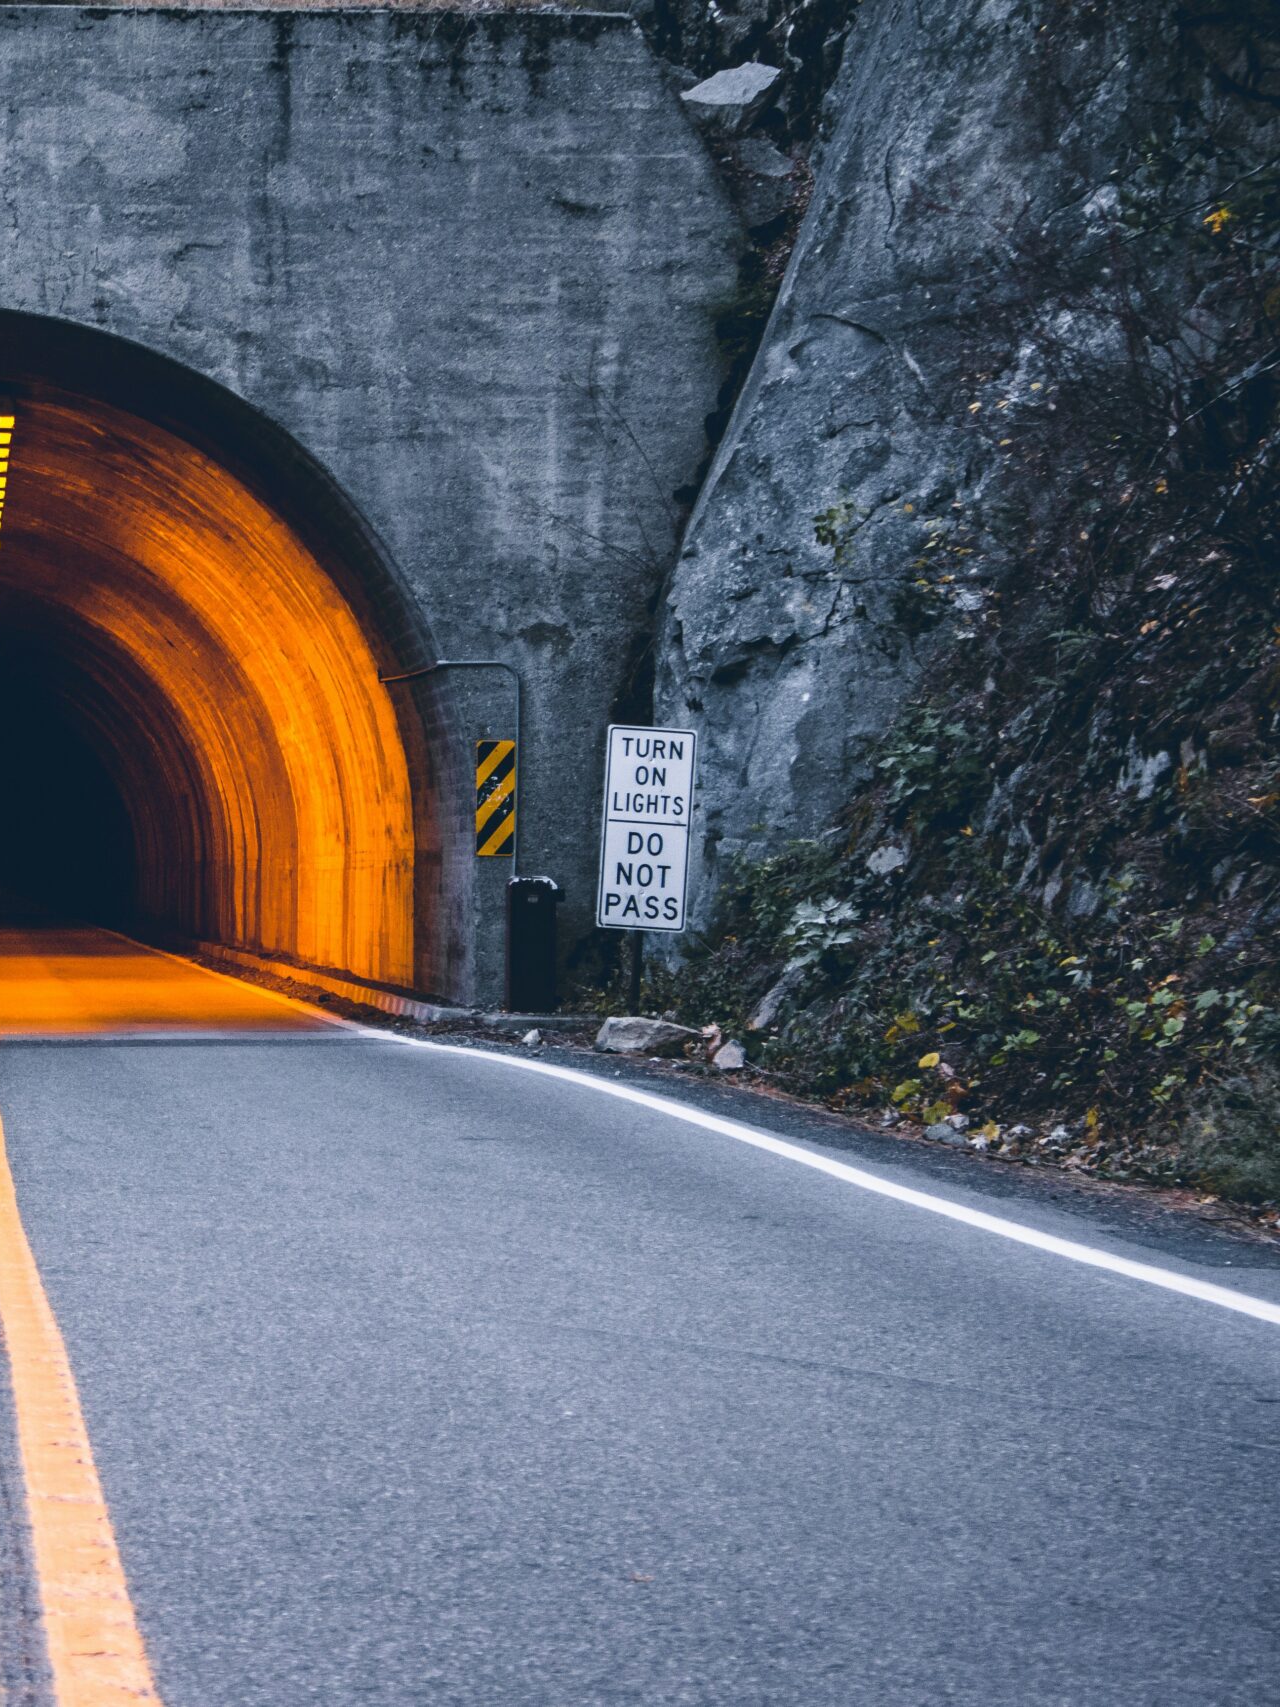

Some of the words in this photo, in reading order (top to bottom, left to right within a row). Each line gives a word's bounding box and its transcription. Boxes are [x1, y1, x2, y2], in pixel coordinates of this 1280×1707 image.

[622, 737, 684, 760] TURN
[635, 766, 667, 786] ON
[613, 792, 684, 815] LIGHTS
[627, 832, 664, 856] DO
[616, 862, 671, 888] NOT
[604, 893, 678, 920] PASS
